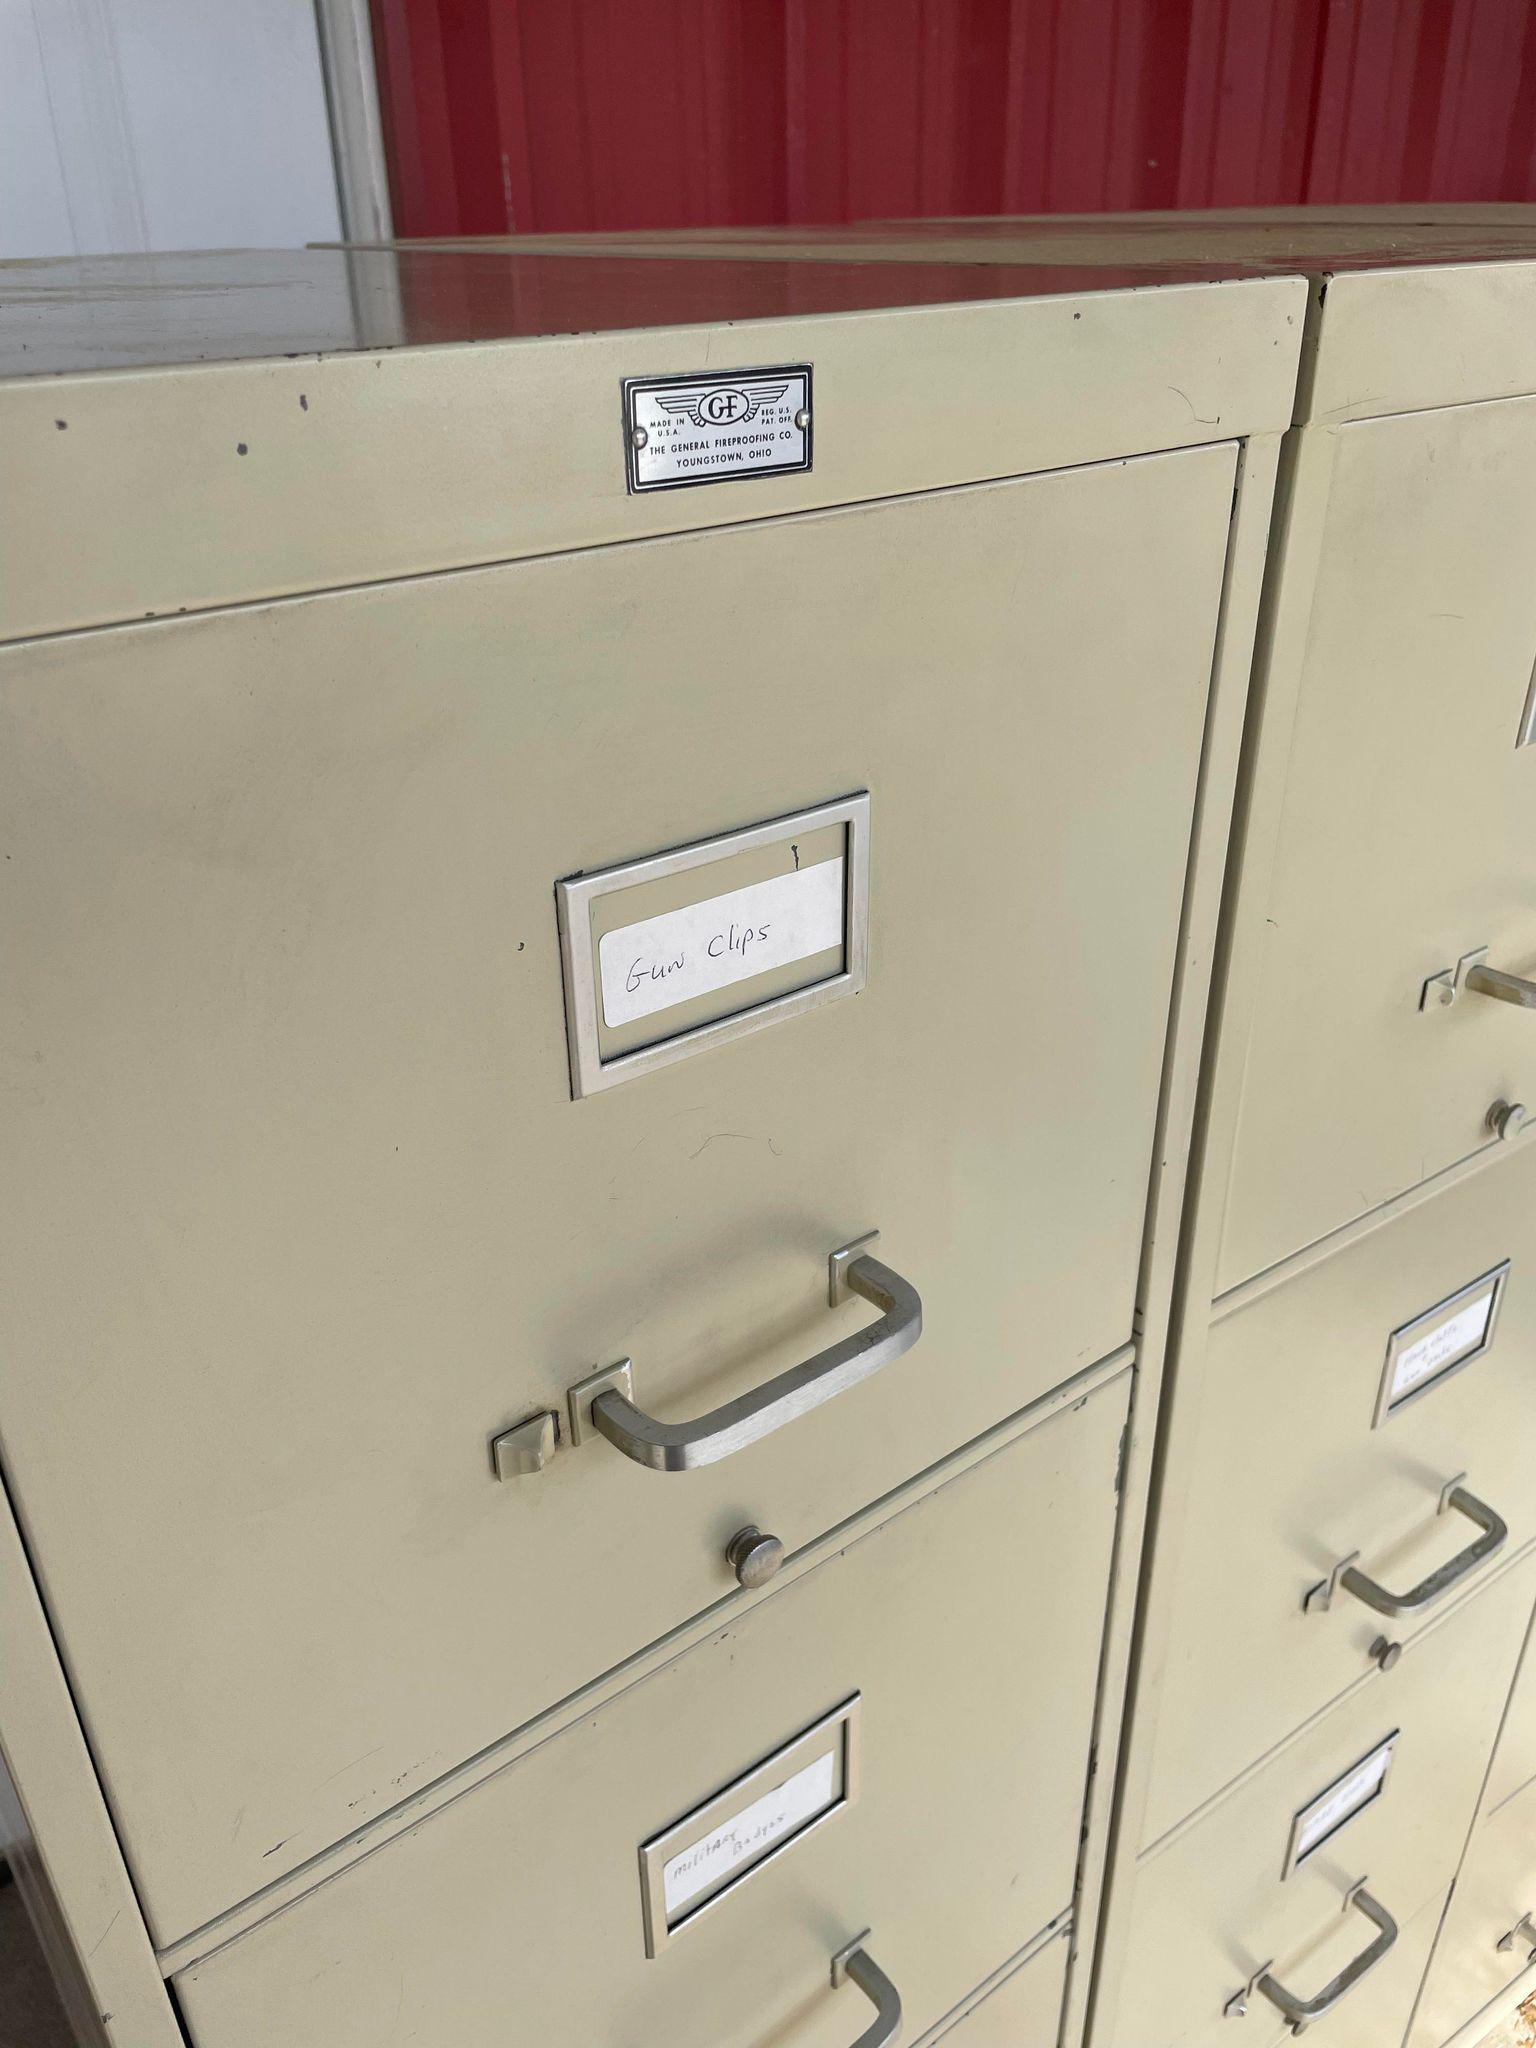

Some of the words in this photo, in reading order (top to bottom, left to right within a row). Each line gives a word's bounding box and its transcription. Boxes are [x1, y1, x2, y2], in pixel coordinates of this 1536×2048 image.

[761, 408, 777, 416] REG.
[650, 420, 671, 428] MADE
[676, 418, 685, 426] IN
[761, 417, 777, 425] PAT.
[778, 416, 793, 424] OFF.
[658, 429, 681, 437] U.S.A.
[650, 446, 666, 455] THE
[671, 441, 710, 453] GENERAL
[715, 433, 775, 448] FIREPROOFING
[779, 431, 793, 440] CO.
[676, 452, 744, 468] YOUNGSTOWN,
[749, 448, 772, 459] OHIO
